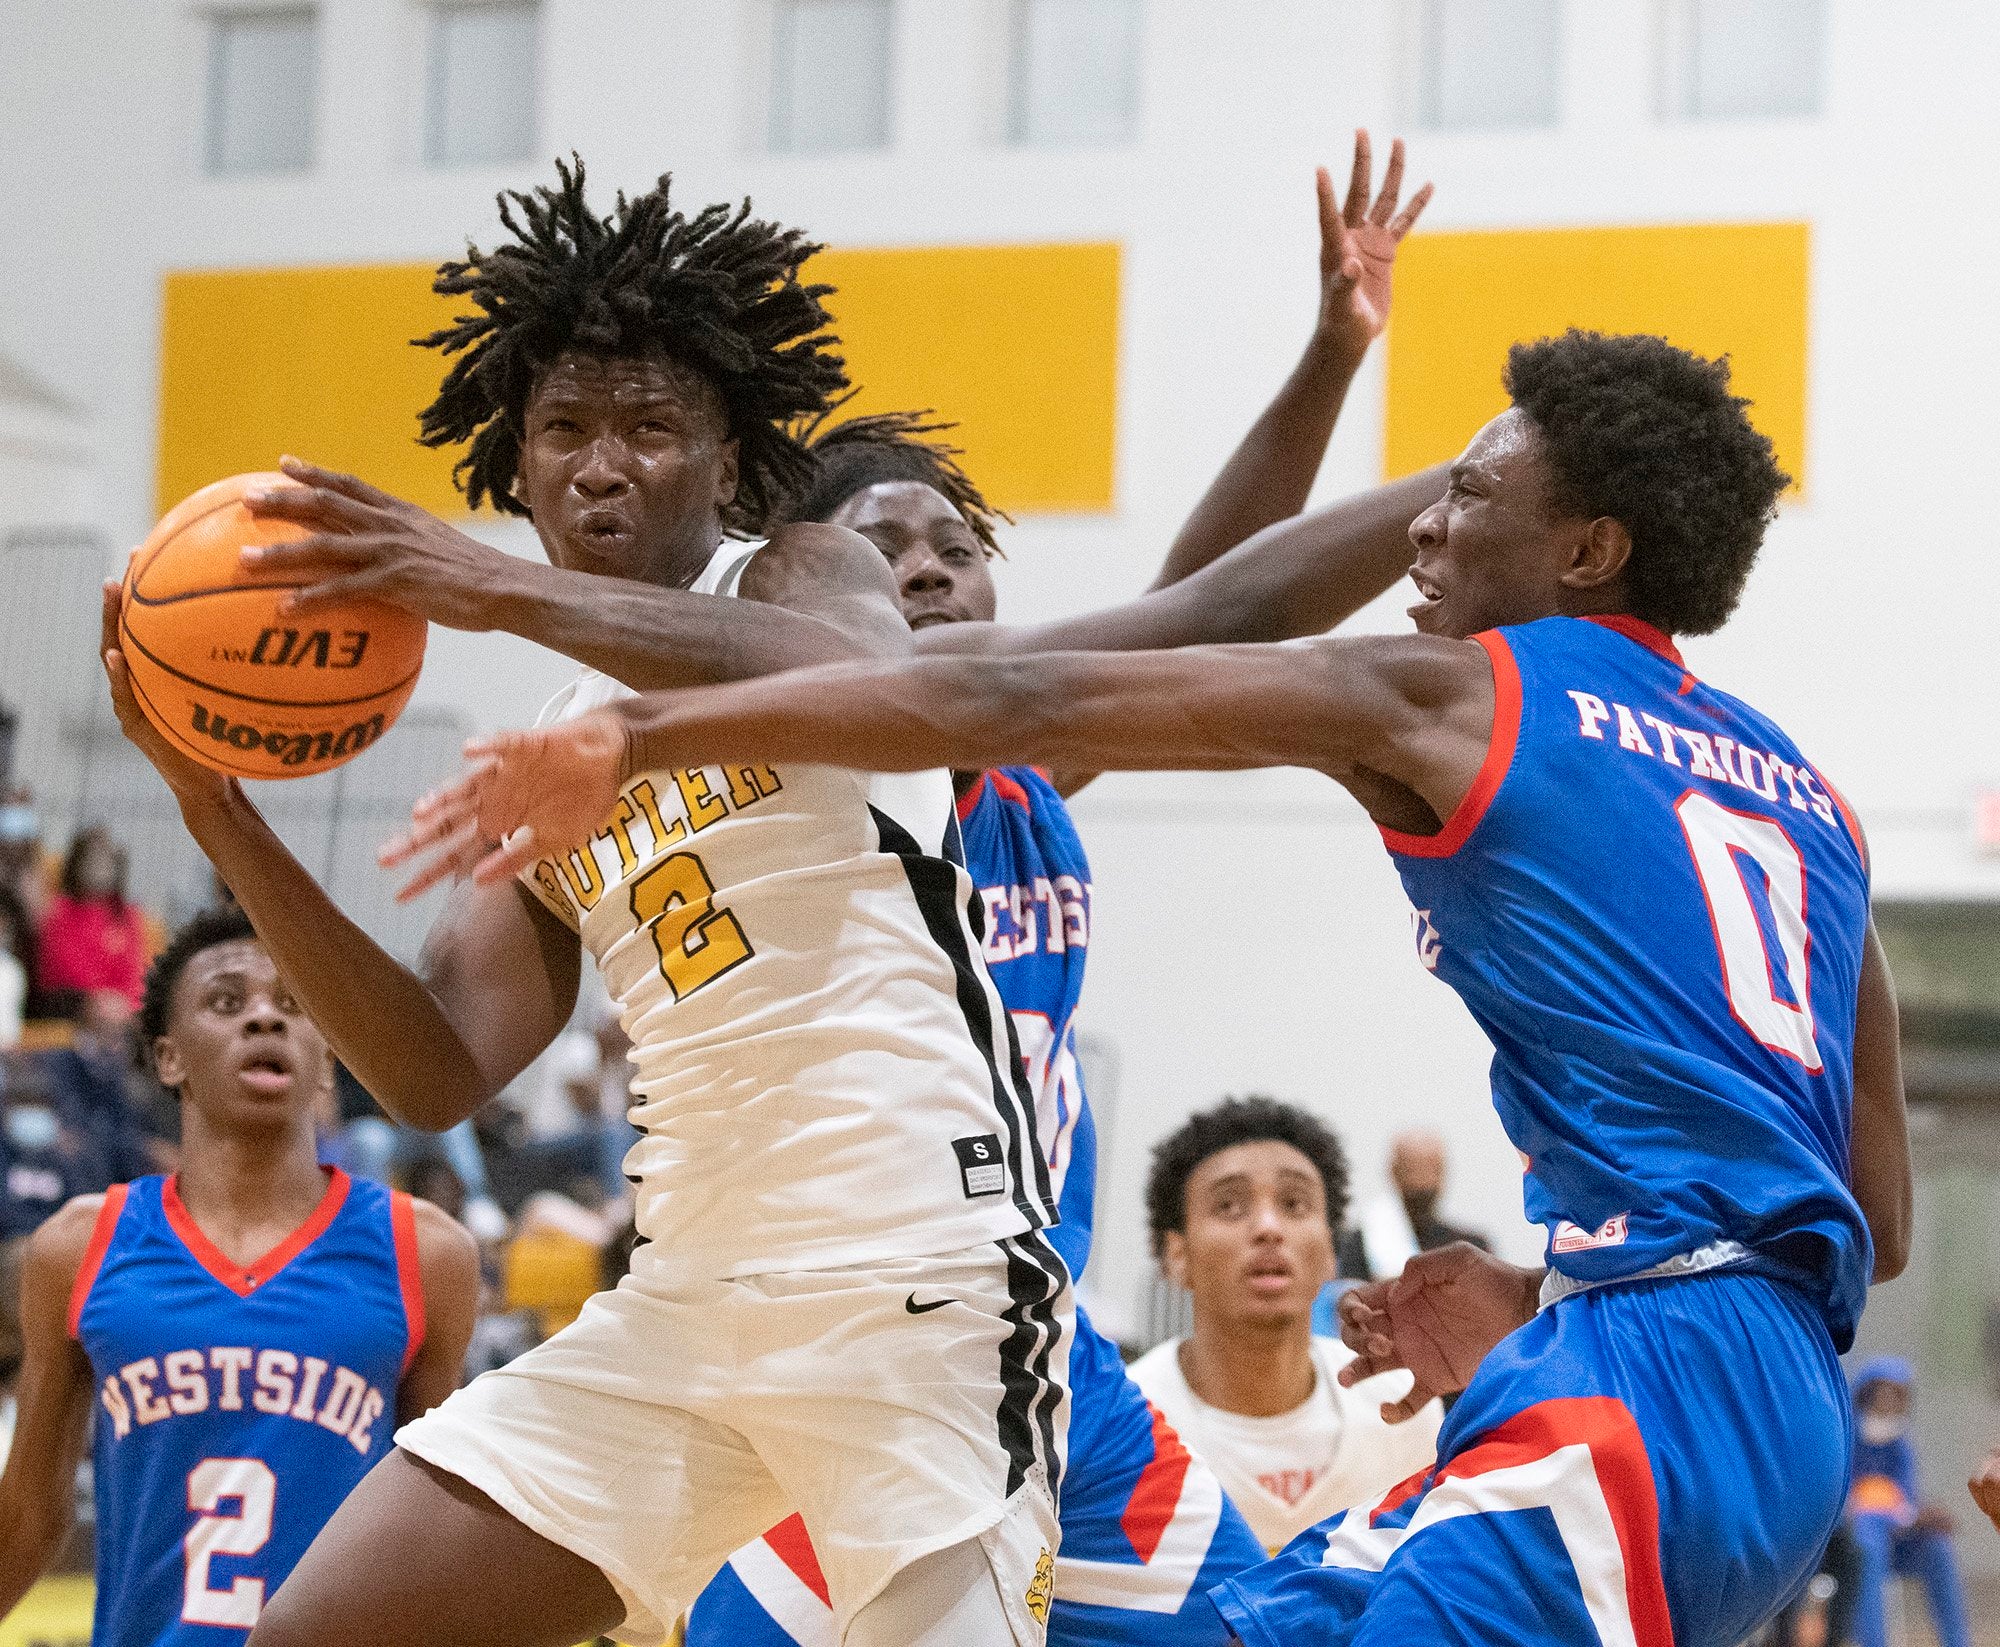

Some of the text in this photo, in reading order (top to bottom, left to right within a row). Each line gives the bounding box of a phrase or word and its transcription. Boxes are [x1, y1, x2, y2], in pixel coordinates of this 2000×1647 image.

[251, 627, 370, 669] EVO
[191, 702, 385, 765] Wilson
[1567, 690, 1838, 828] PATRIOTS
[629, 851, 756, 1004] 2
[1673, 788, 1823, 1076] 0
[972, 1142, 990, 1160] S
[182, 1456, 278, 1630] 2
